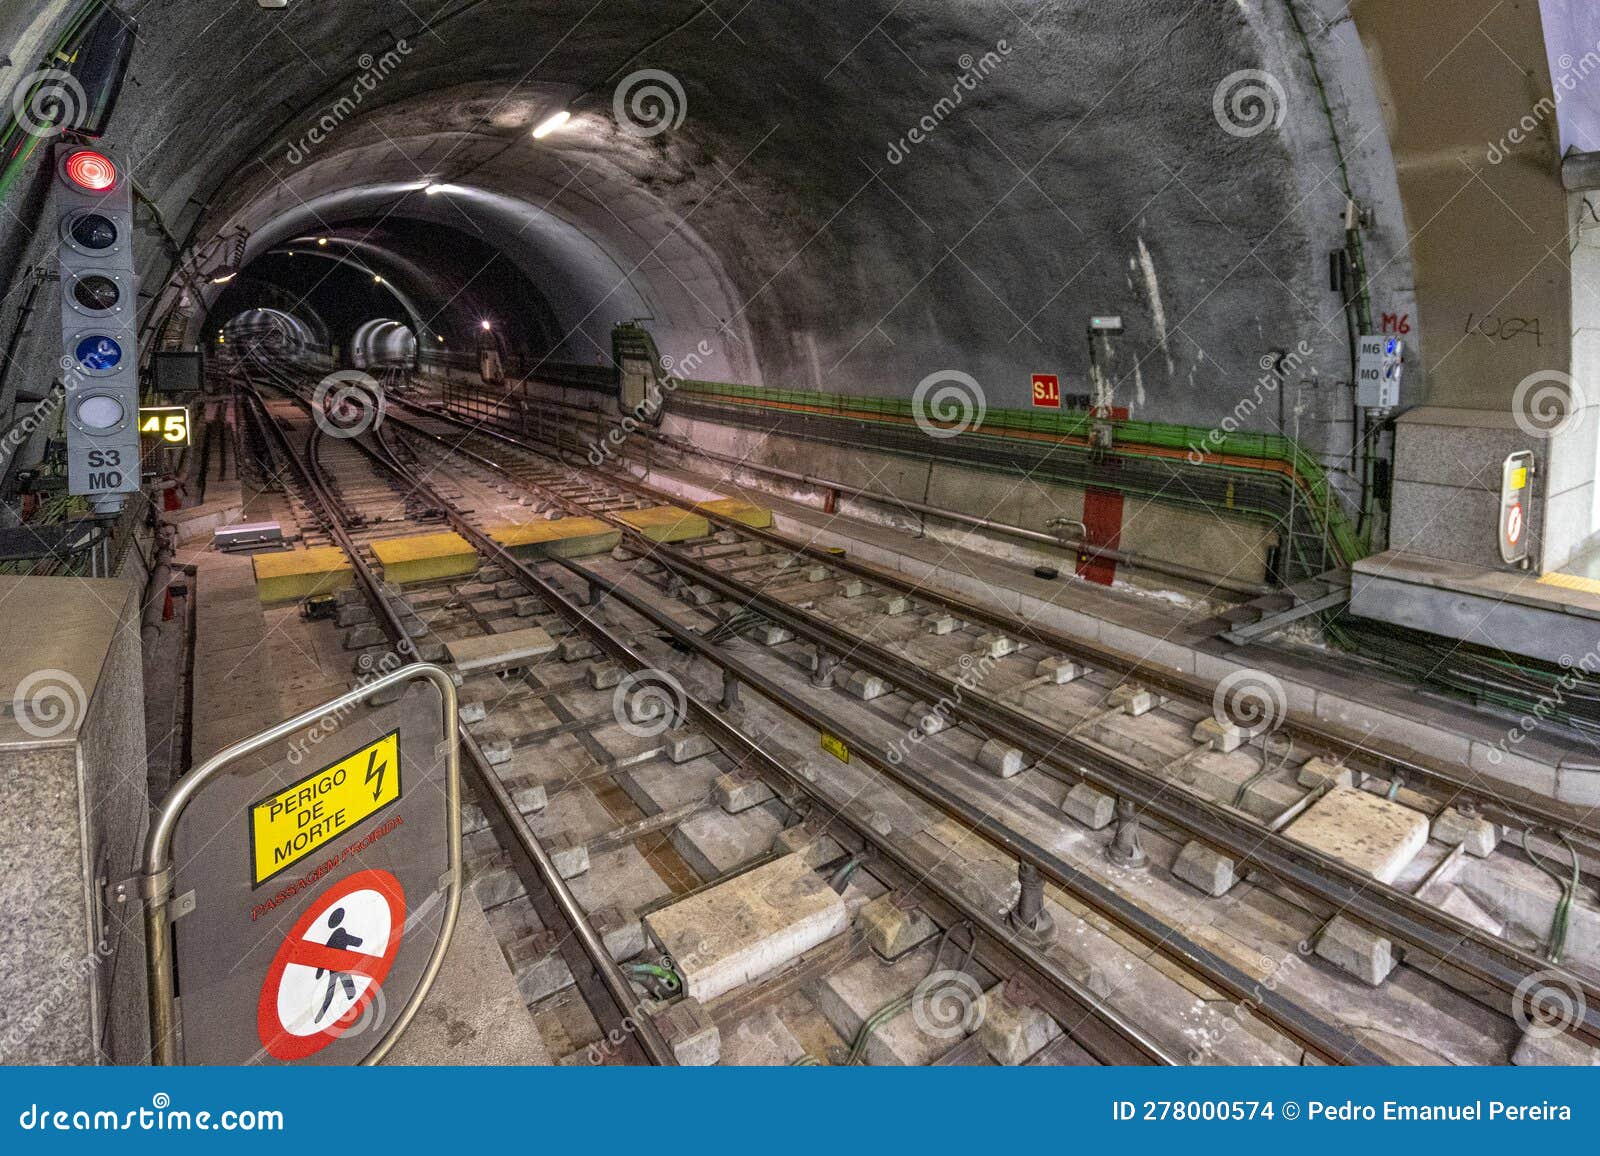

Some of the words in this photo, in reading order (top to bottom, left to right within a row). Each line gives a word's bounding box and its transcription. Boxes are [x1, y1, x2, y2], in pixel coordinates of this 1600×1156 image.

[1381, 312, 1411, 334] M6
[1362, 343, 1380, 354] M6
[1034, 381, 1059, 400] S.I.
[88, 450, 121, 468] S3
[270, 769, 347, 822] PERIGO
[297, 801, 324, 829] DE
[274, 808, 346, 864] MORTE
[252, 854, 340, 921] PASSAGEM
